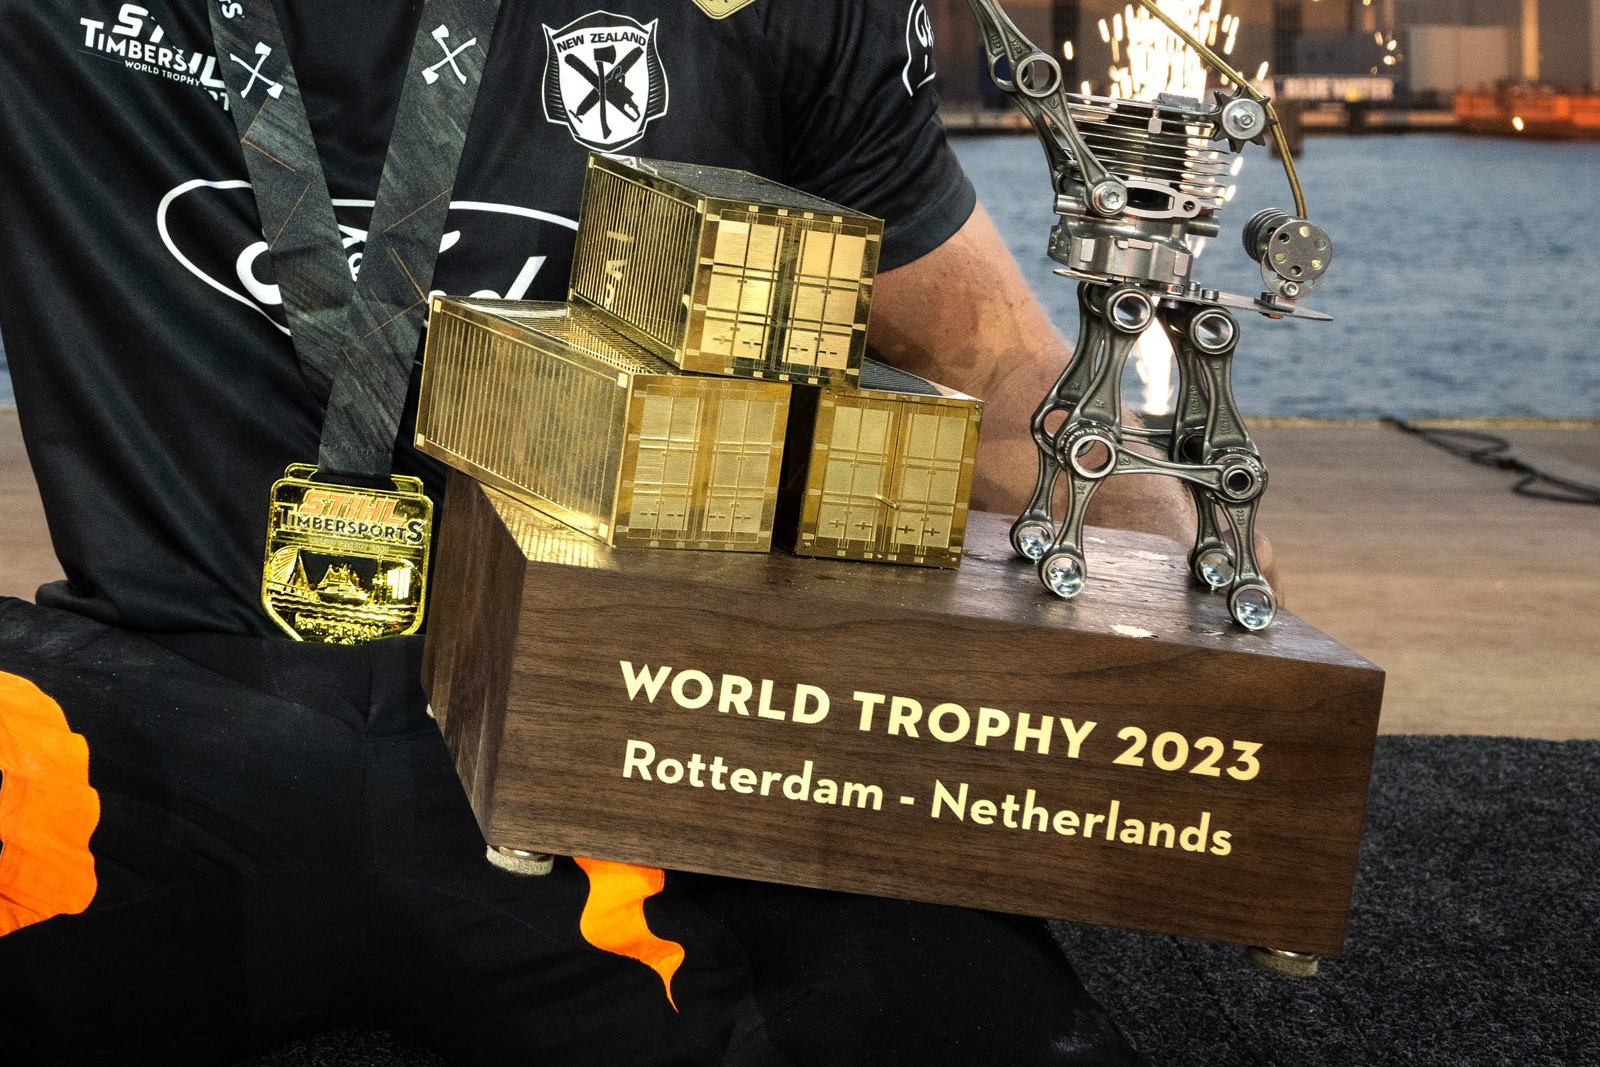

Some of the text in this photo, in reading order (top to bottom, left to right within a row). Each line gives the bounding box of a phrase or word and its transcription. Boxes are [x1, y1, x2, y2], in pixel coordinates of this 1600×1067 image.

[556, 32, 646, 53] NEW ZEALAND
[124, 59, 200, 87] WORLD TROPHY
[277, 504, 423, 543] TIMBERSPORTS
[301, 489, 406, 525] STIHL
[619, 659, 1263, 782] WORLD TROPHY 2023
[622, 739, 884, 811] Rotterdam
[930, 779, 1233, 857] Netherlands
